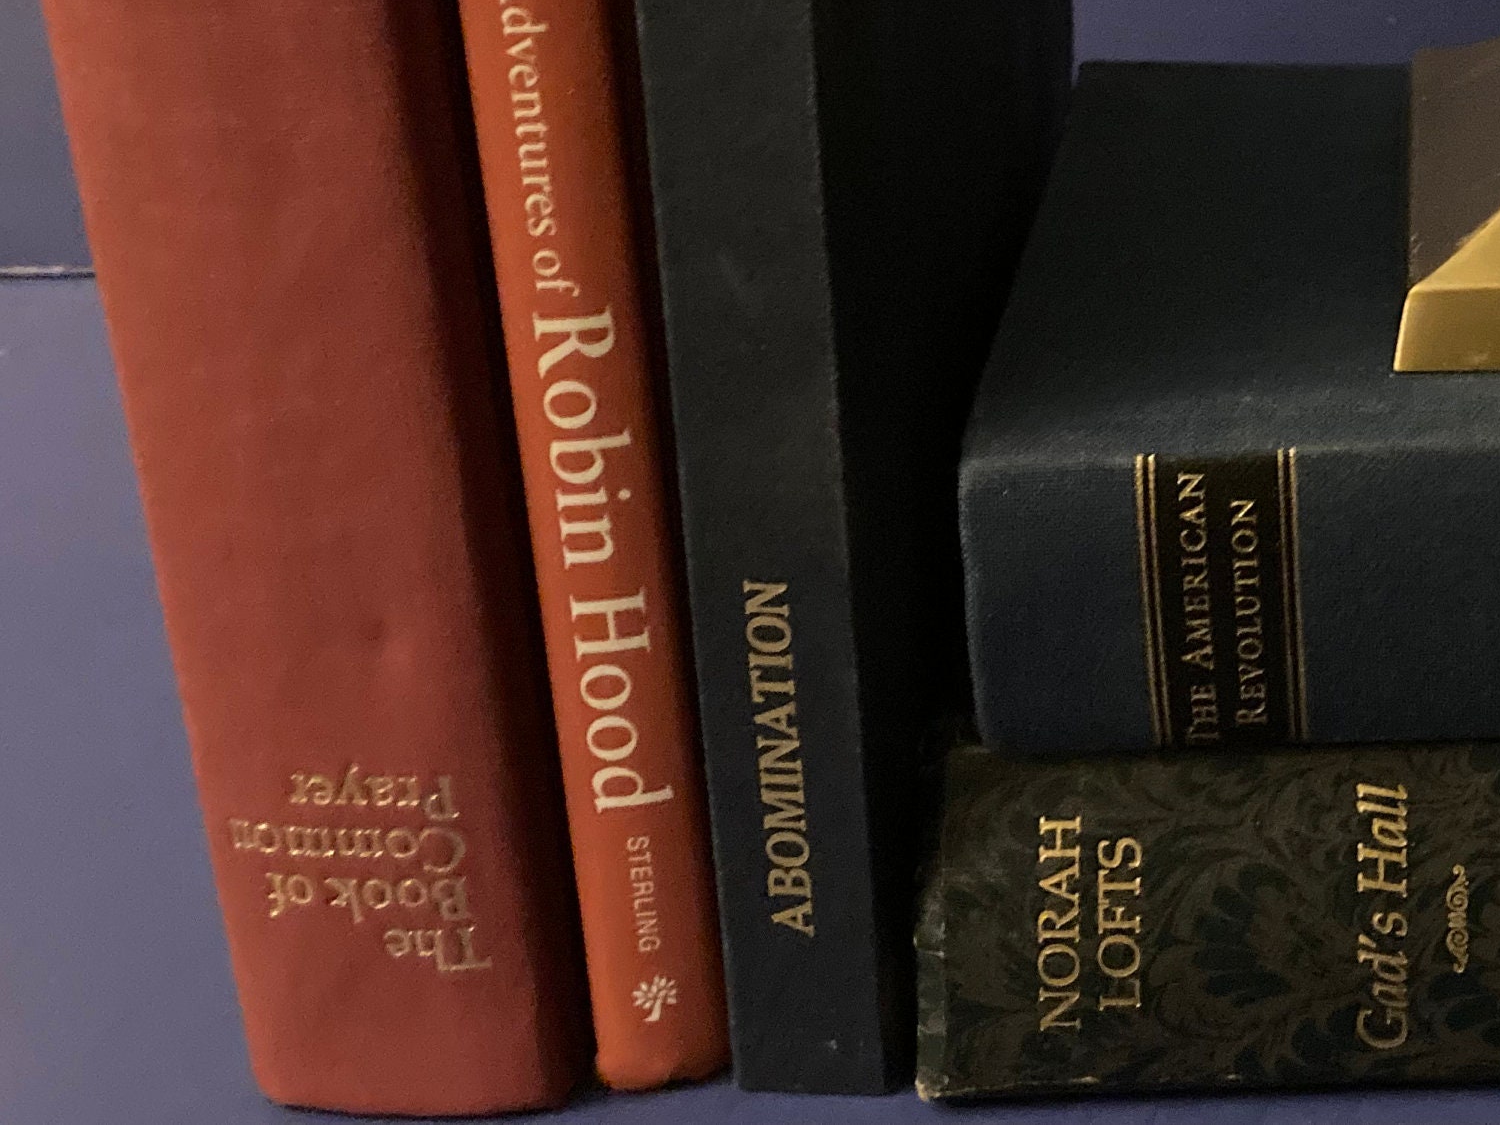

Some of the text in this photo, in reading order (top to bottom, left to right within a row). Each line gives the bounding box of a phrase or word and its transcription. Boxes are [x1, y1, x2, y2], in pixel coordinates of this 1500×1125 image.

[532, 248, 580, 298] of
[532, 304, 632, 570] Robin
[568, 586, 676, 814] Hood
[1177, 470, 1221, 743] THE AMERICAN
[1229, 498, 1269, 728] REVOLUTION
[228, 818, 467, 874] Common
[288, 763, 461, 821] Prayer
[743, 578, 816, 939] ABOMINATION
[263, 872, 471, 925] Book of
[382, 923, 493, 974] The
[626, 833, 661, 954] STERLING
[1036, 814, 1083, 1033] NORAH
[1096, 836, 1144, 1013] LOFTS
[1356, 782, 1409, 1050] Gad's Hall
